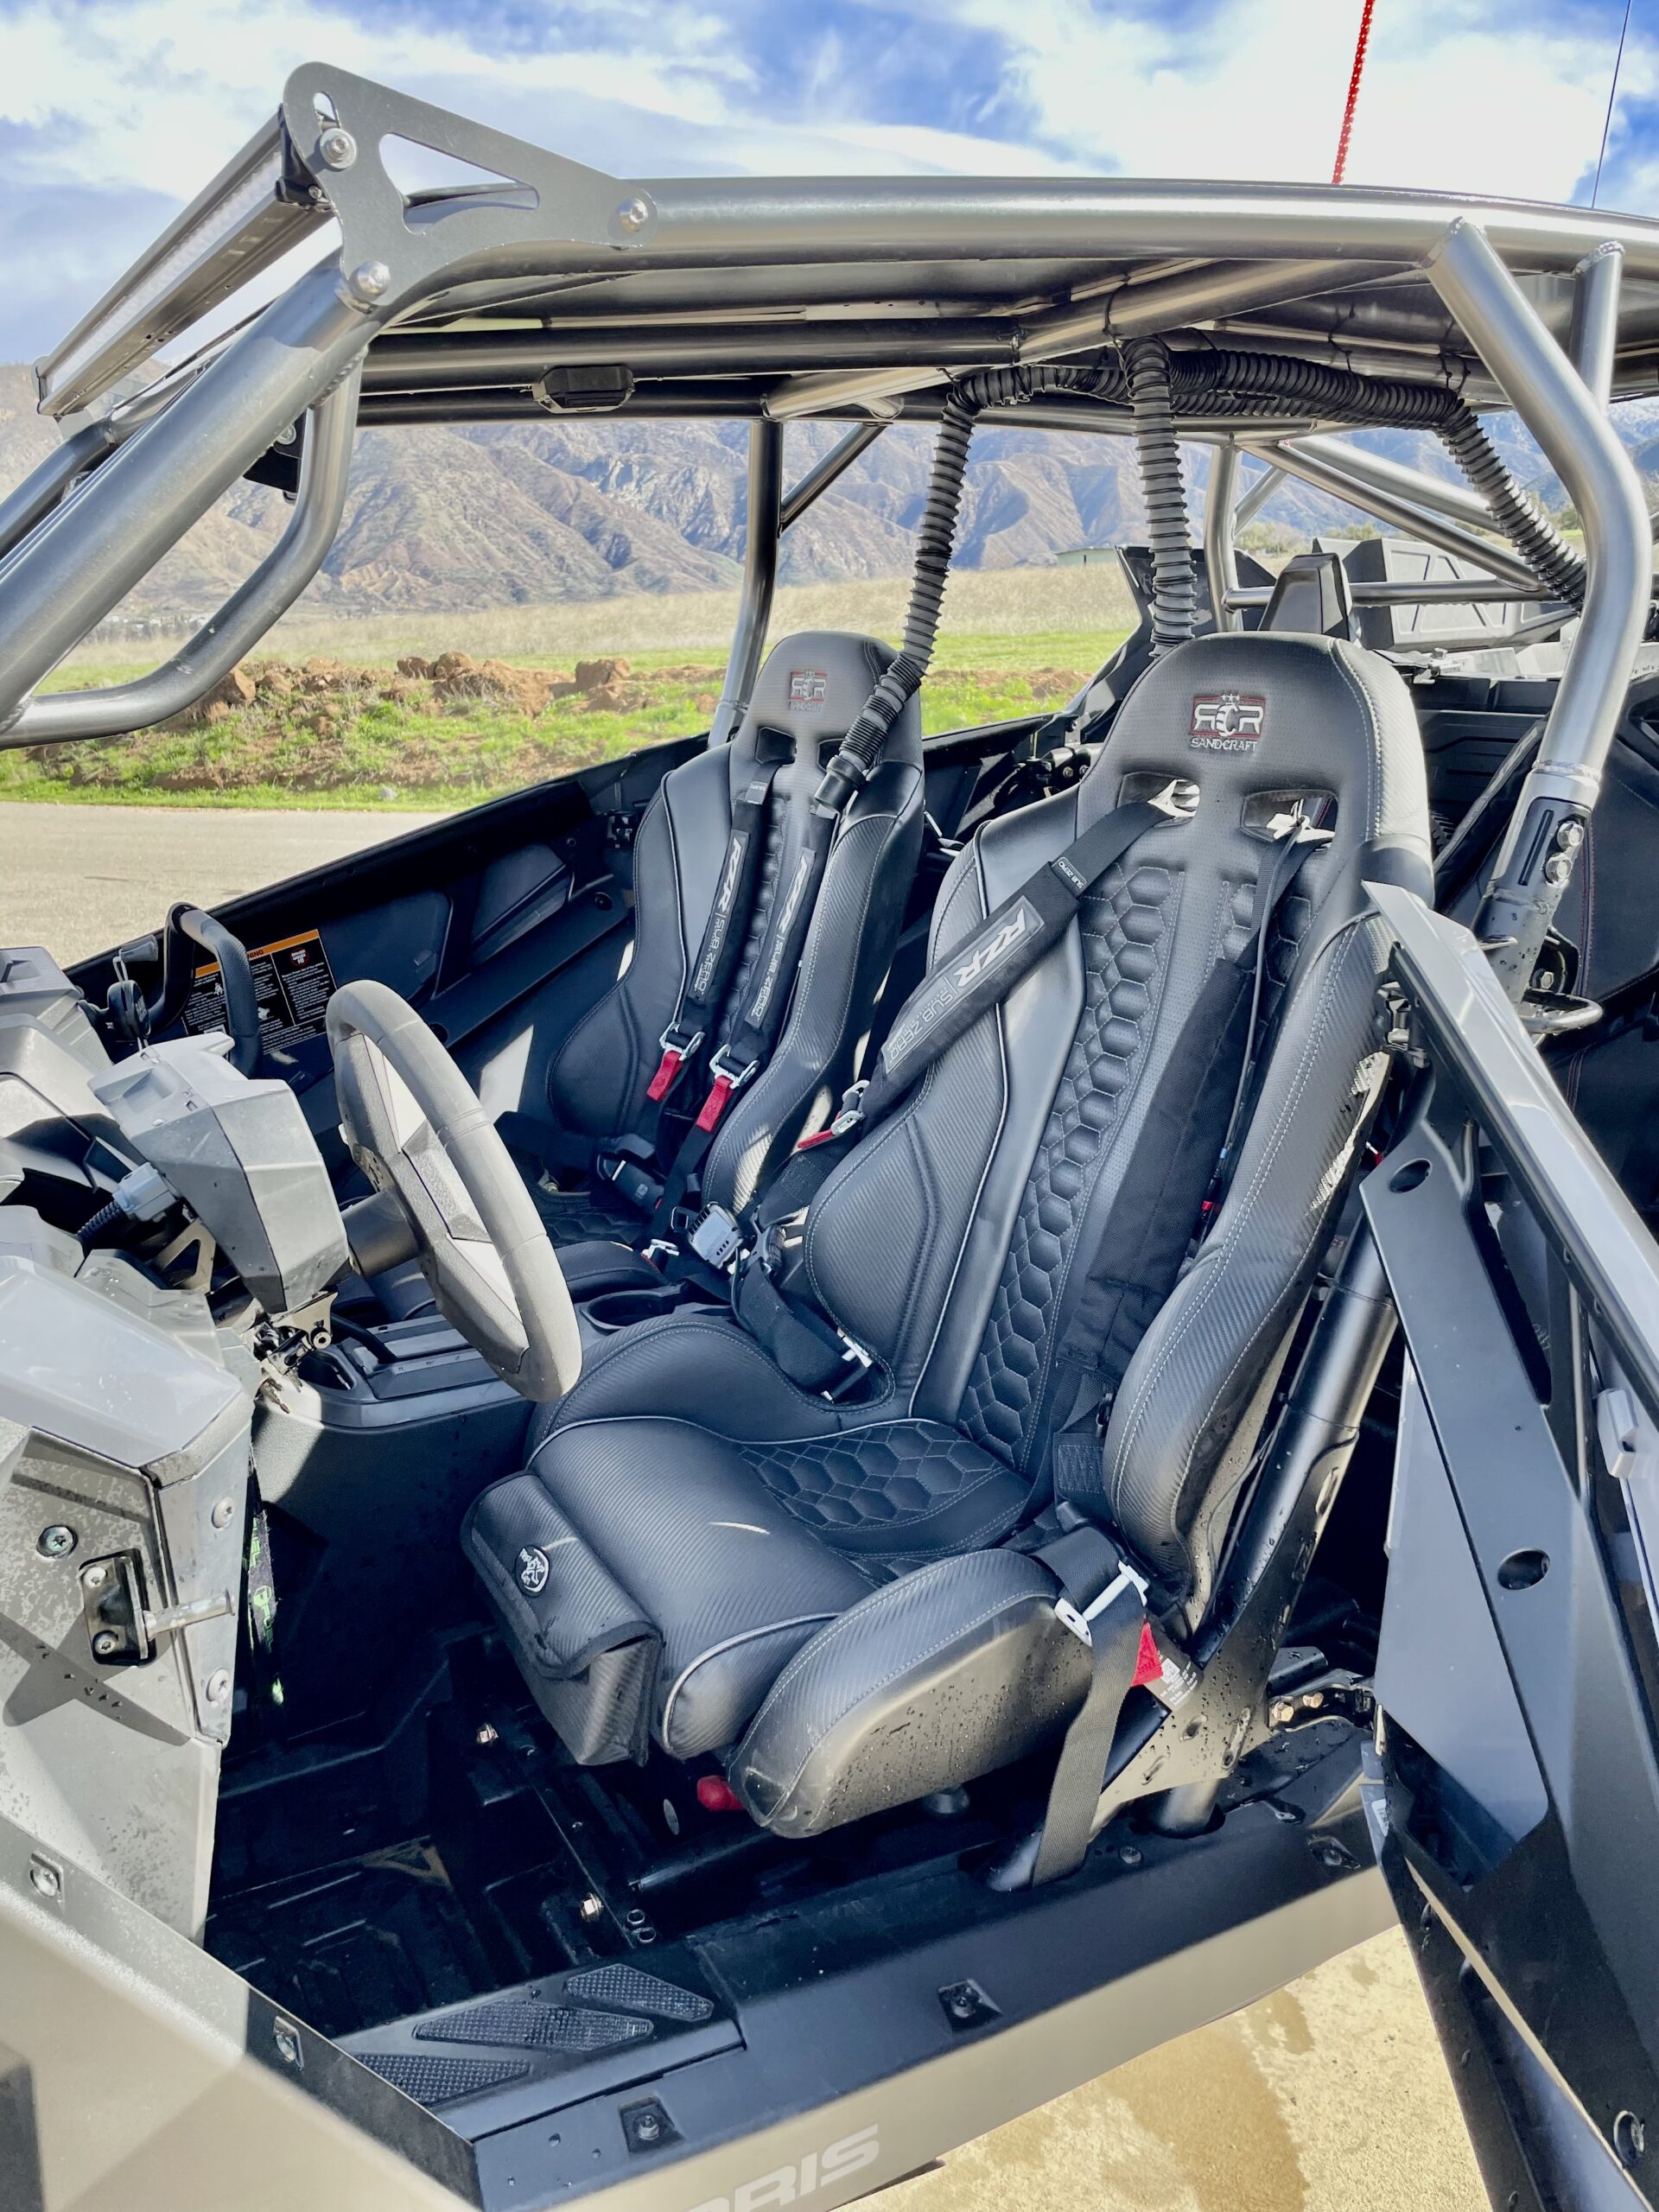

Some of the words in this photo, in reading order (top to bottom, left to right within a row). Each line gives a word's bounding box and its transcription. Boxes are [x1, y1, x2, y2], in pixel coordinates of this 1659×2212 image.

[1190, 737, 1258, 752] SANDCRAFT
[718, 836, 741, 912] RZR
[1058, 861, 1074, 878] ZERO
[1071, 875, 1084, 889] SUB
[712, 917, 725, 950] SUB
[953, 908, 1026, 987] RZR
[699, 952, 715, 991] ZERO
[922, 989, 953, 1022] SUB
[891, 1020, 923, 1059] ZERO
